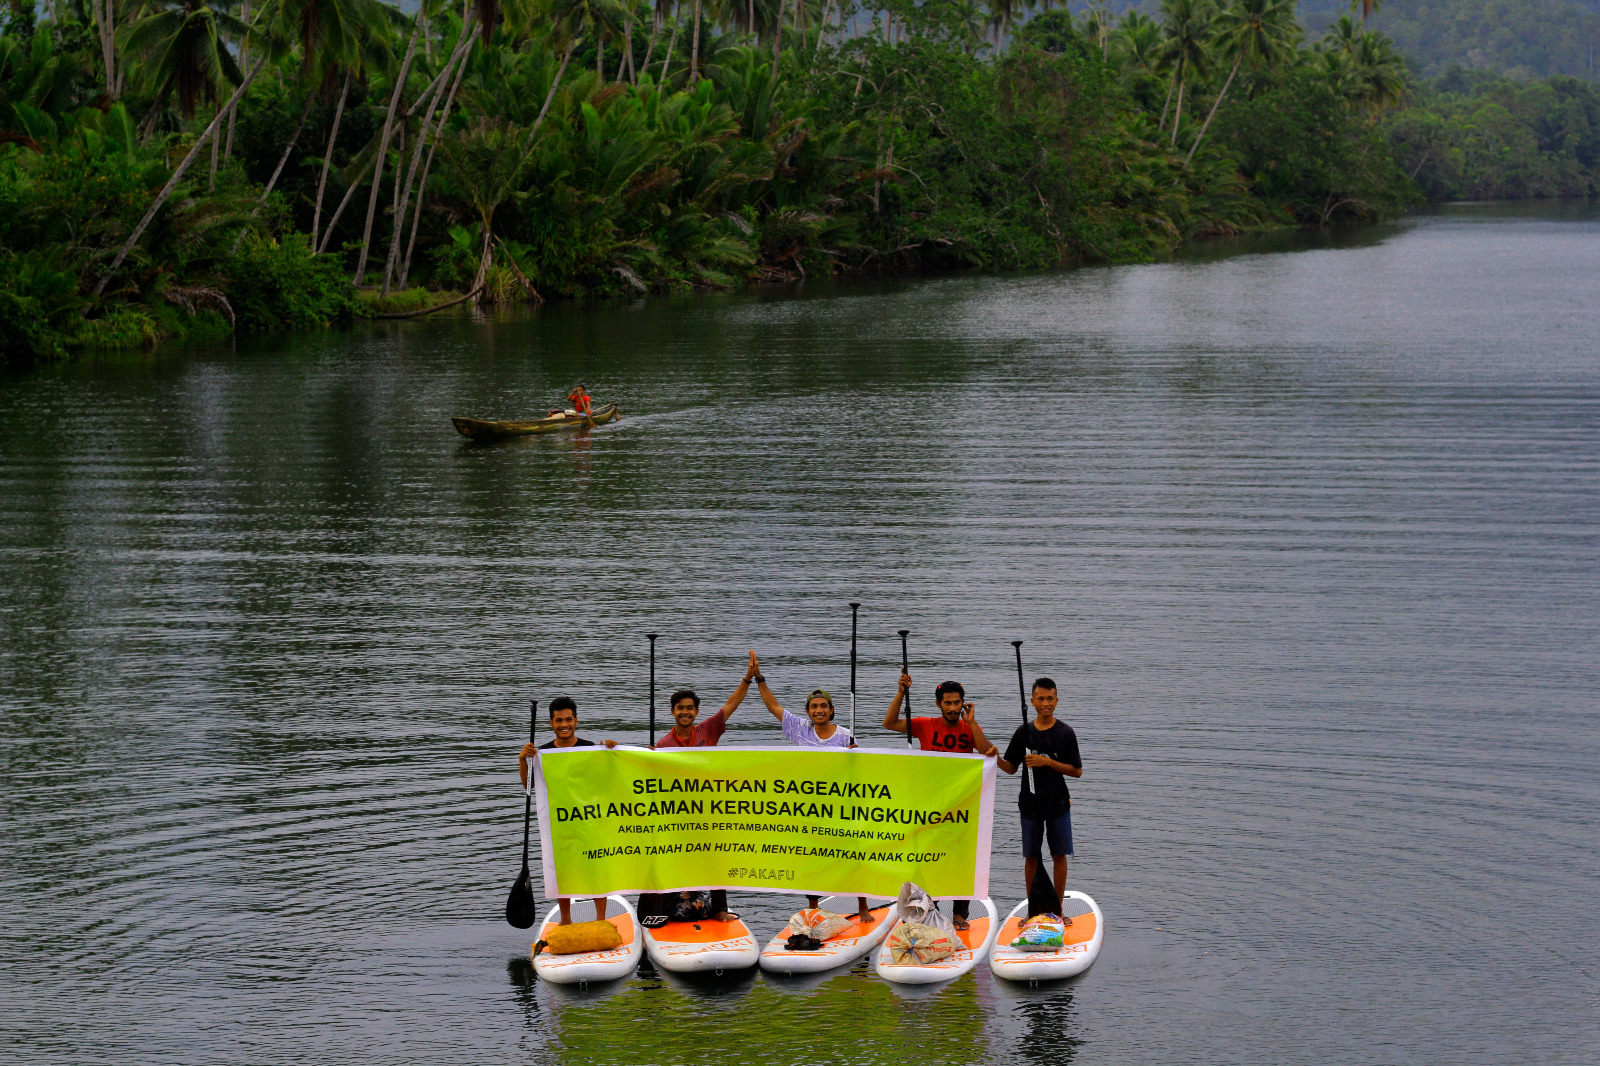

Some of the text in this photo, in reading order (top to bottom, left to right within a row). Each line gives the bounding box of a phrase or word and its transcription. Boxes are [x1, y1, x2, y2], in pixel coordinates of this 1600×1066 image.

[632, 778, 892, 799] SELAMATKAN SAGEA/KIYA
[556, 800, 969, 826] DARI ANCAMAN KERUSAKAN LINGKUNGAN
[618, 822, 905, 841] AKIBAT AKTIVITAS PERTAMBANGAN & PERUSAHAN KAYU
[645, 843, 683, 856] TANAH
[685, 842, 711, 853] DAN
[714, 842, 758, 855] HUTAN,
[761, 843, 866, 861] MENYELAMATKAN
[868, 851, 903, 863] ANAK
[727, 867, 795, 881] #PAKAFU
